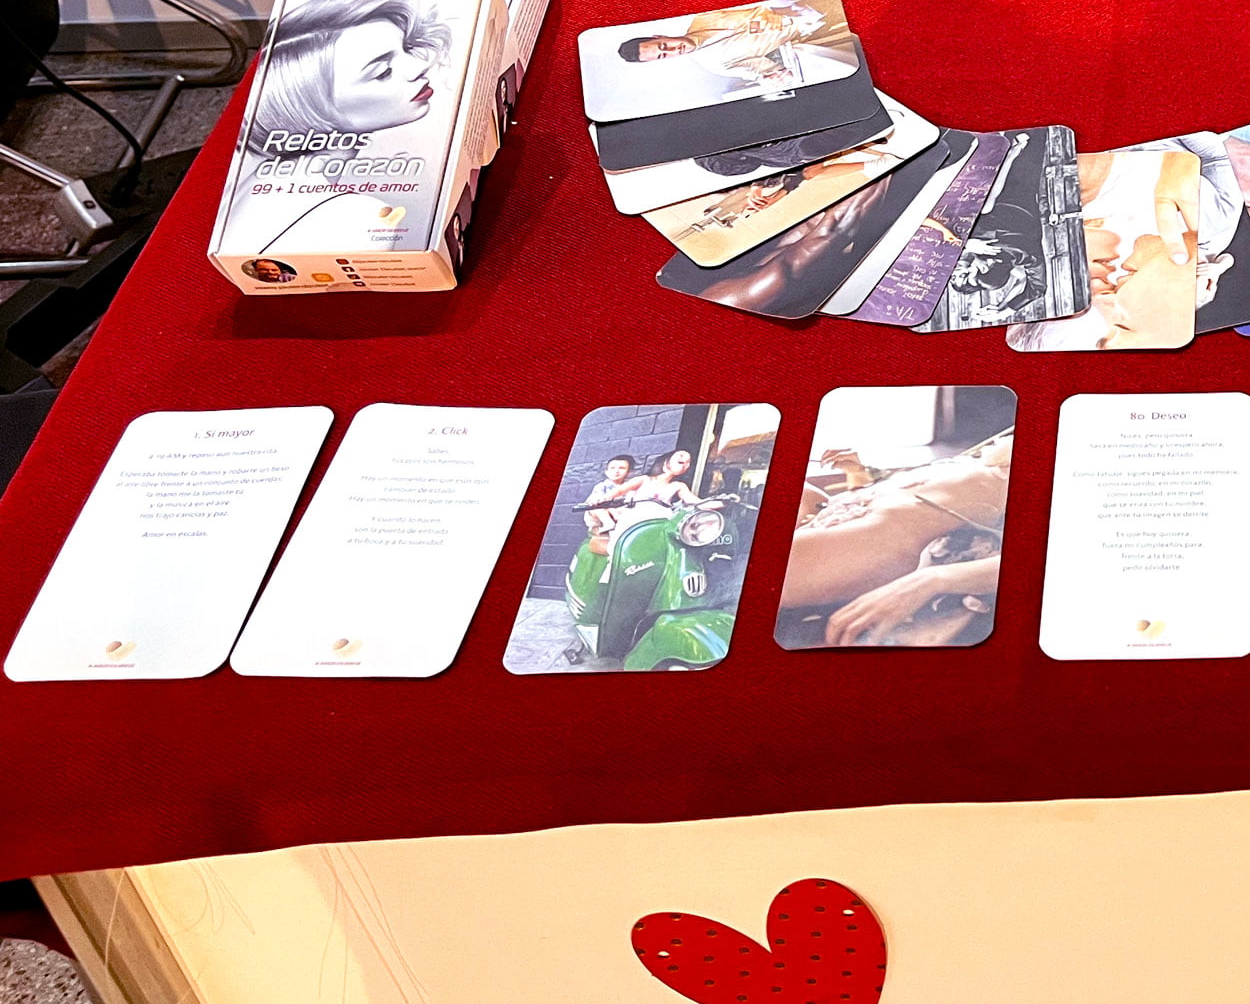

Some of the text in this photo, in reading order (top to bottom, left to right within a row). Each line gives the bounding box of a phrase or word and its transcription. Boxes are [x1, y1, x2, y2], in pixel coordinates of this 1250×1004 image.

[262, 129, 373, 152] Relatos
[256, 152, 426, 180] del Corazón
[251, 182, 420, 195] 99 + 1 cuentos de amor.
[1151, 412, 1187, 420] Deseo
[217, 429, 255, 440] mayor
[441, 426, 469, 435] Click
